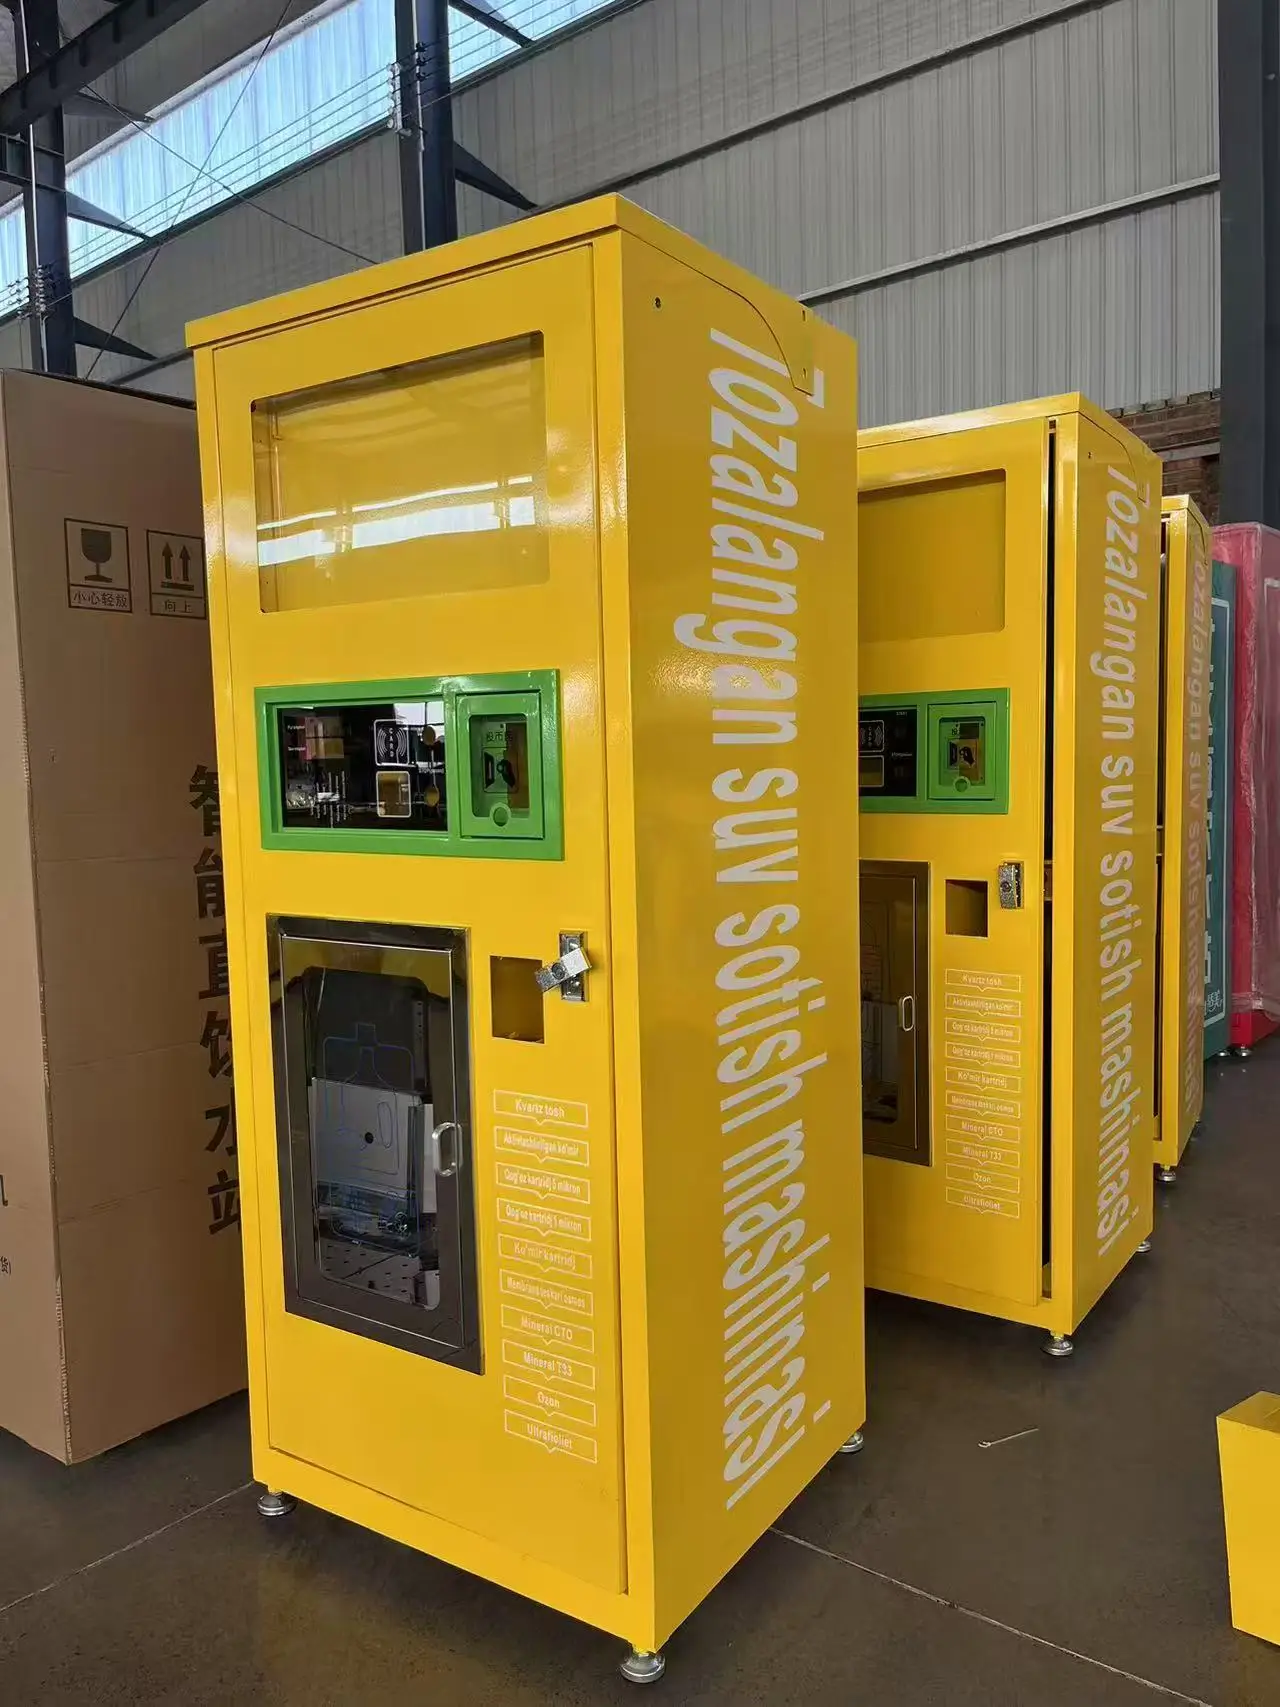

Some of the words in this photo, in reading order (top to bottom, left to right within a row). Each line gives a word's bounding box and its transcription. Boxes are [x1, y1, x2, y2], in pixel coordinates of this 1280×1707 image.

[673, 327, 825, 745] Tozalangan
[72, 591, 128, 609] 小心轻放
[164, 599, 196, 614] 向上
[1090, 464, 1151, 741] Tozalangan
[711, 767, 799, 883] suv
[1100, 755, 1135, 836] suv
[1099, 849, 1143, 1004] sotish
[715, 903, 828, 1135] sotish
[1097, 1011, 1143, 1258] mashinasi
[521, 1315, 553, 1336] Mineral
[523, 1351, 555, 1372] Mineral
[722, 1118, 832, 1511] mashinasi
[537, 1391, 560, 1409] Ozon
